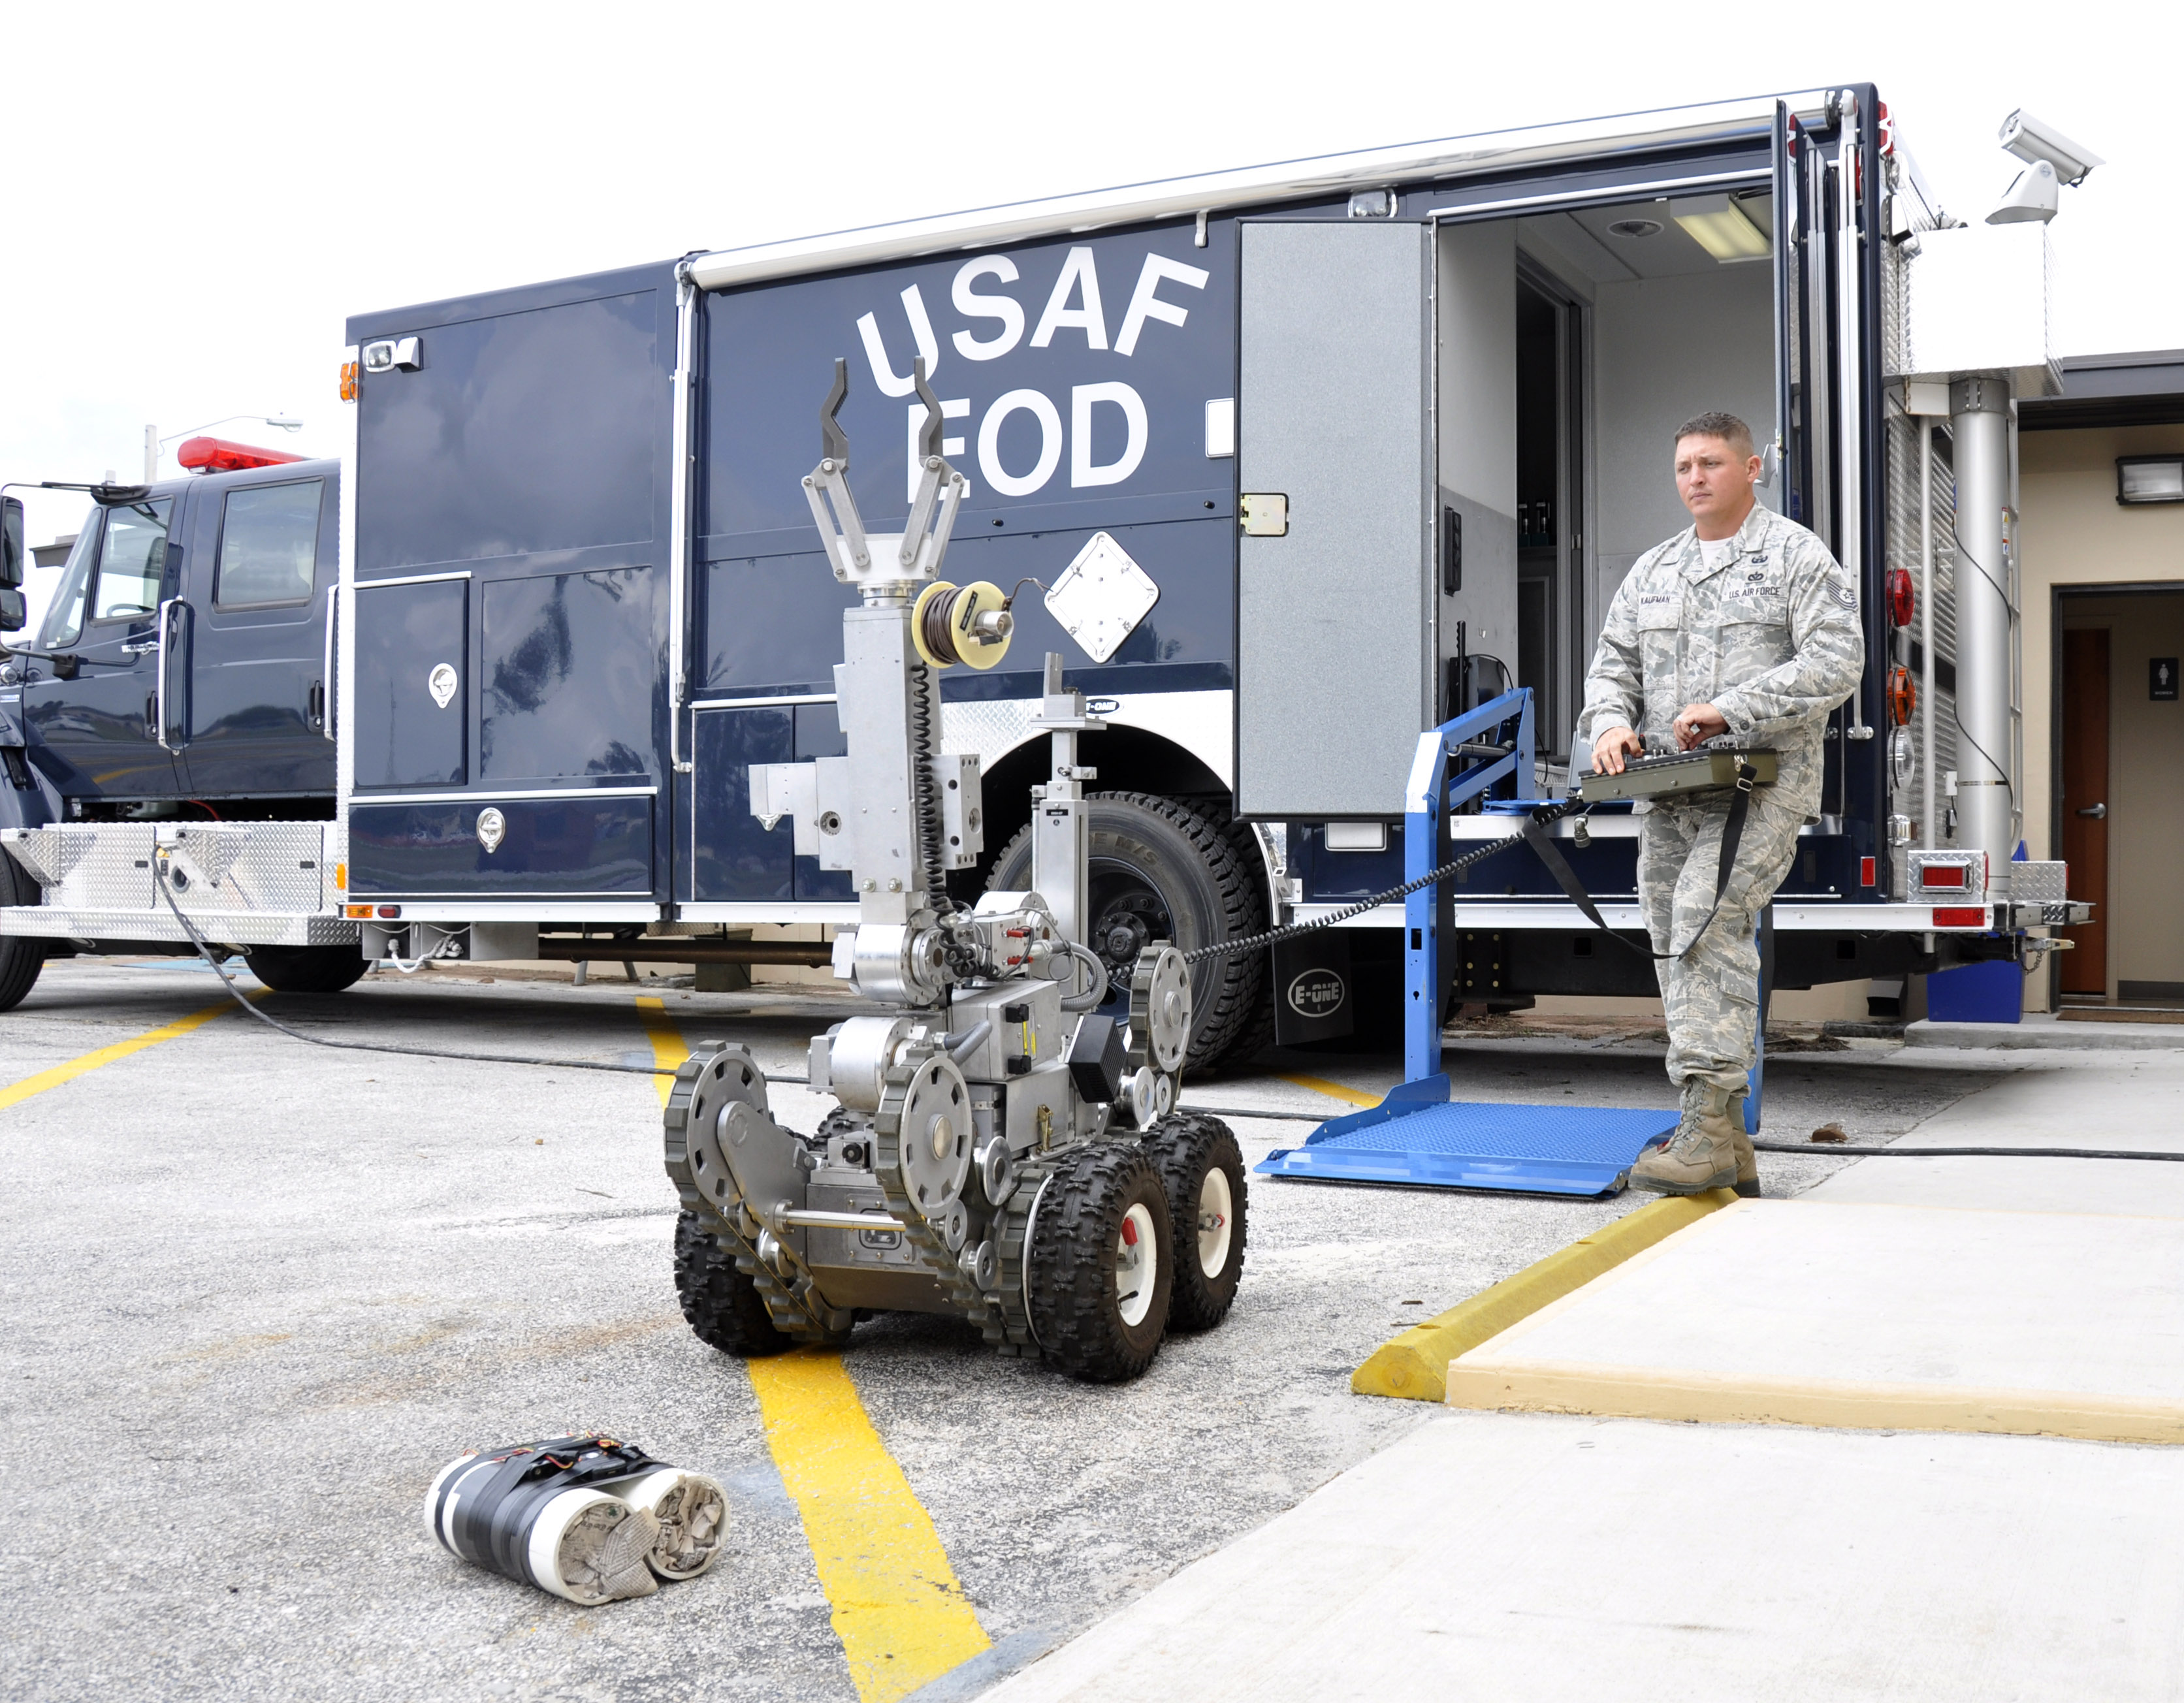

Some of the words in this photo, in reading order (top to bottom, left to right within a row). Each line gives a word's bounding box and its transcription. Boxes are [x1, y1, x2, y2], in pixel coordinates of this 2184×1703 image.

[856, 246, 1210, 397] USAF
[907, 381, 1148, 503] EOD
[1640, 596, 1671, 605] KAUFMAN
[1742, 588, 1754, 596] AIR
[1756, 586, 1780, 596] FORCE
[1295, 981, 1339, 1004] E-ONE
